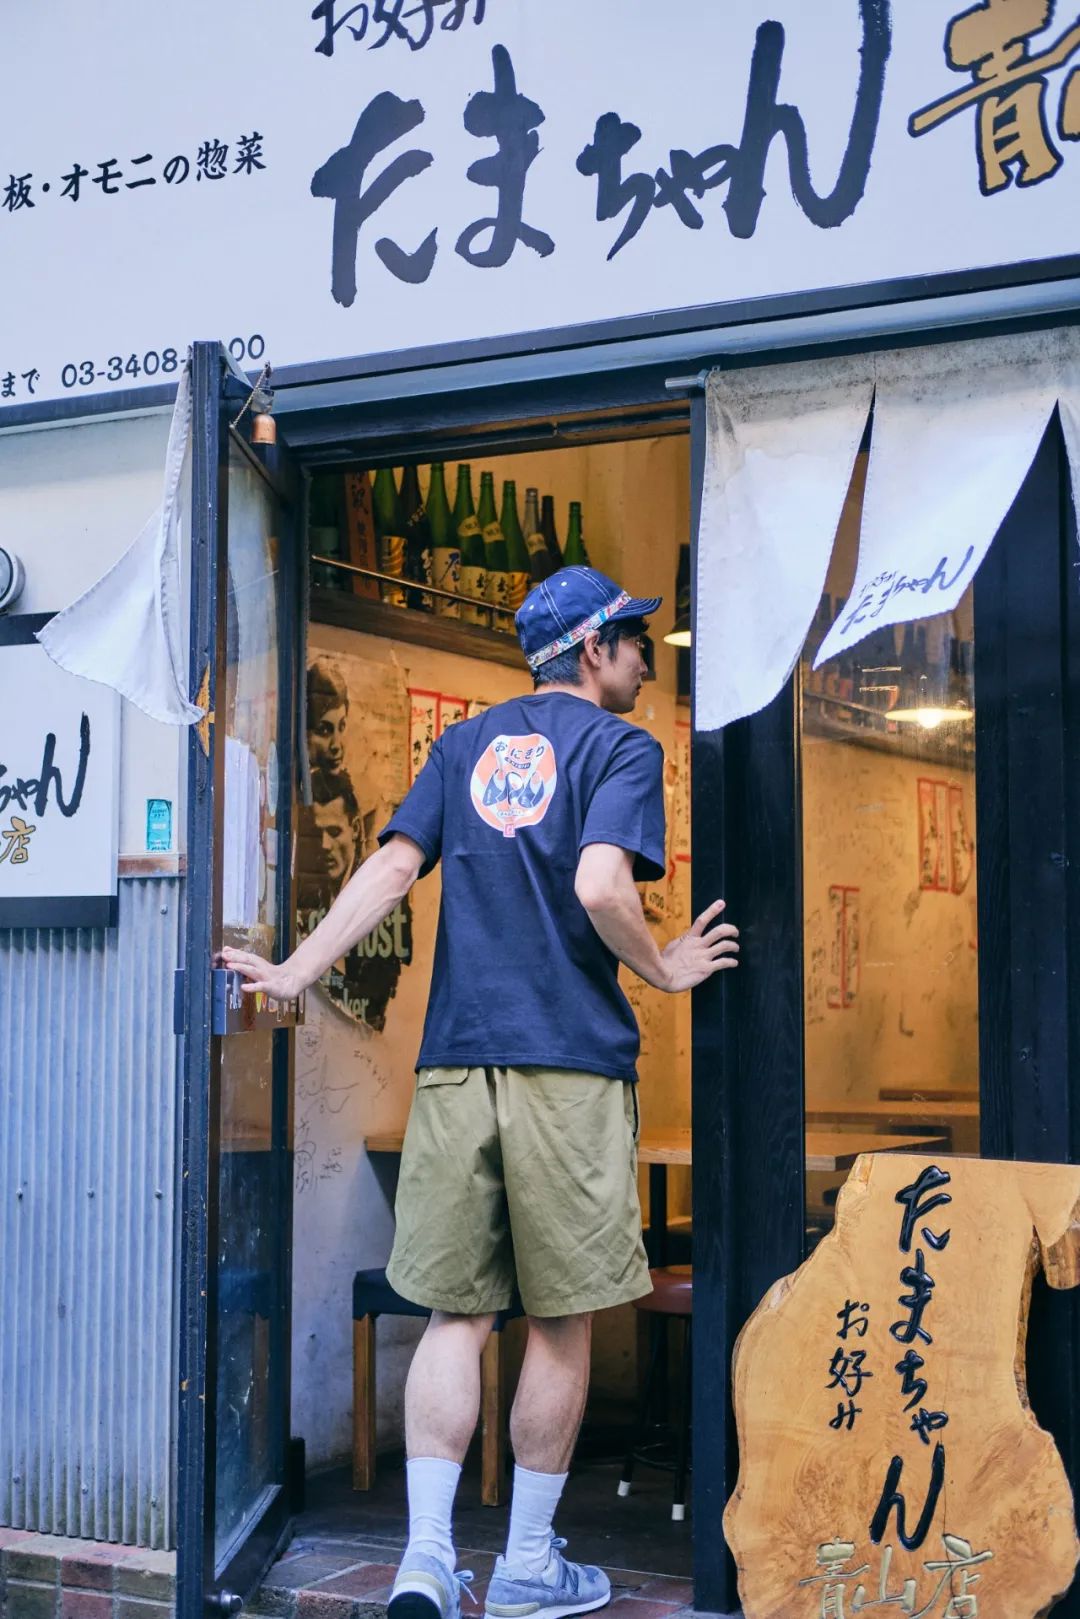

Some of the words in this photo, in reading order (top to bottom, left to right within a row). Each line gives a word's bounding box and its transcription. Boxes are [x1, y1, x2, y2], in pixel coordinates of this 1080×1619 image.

[311, 0, 891, 308] たまちゃん
[907, 0, 1080, 197] 青
[1, 368, 41, 398] まで
[61, 334, 265, 388] 03-3408-00
[825, 1301, 874, 1432] お好み
[869, 1165, 953, 1552] たまちゃん
[799, 1536, 994, 1619] 青山店
